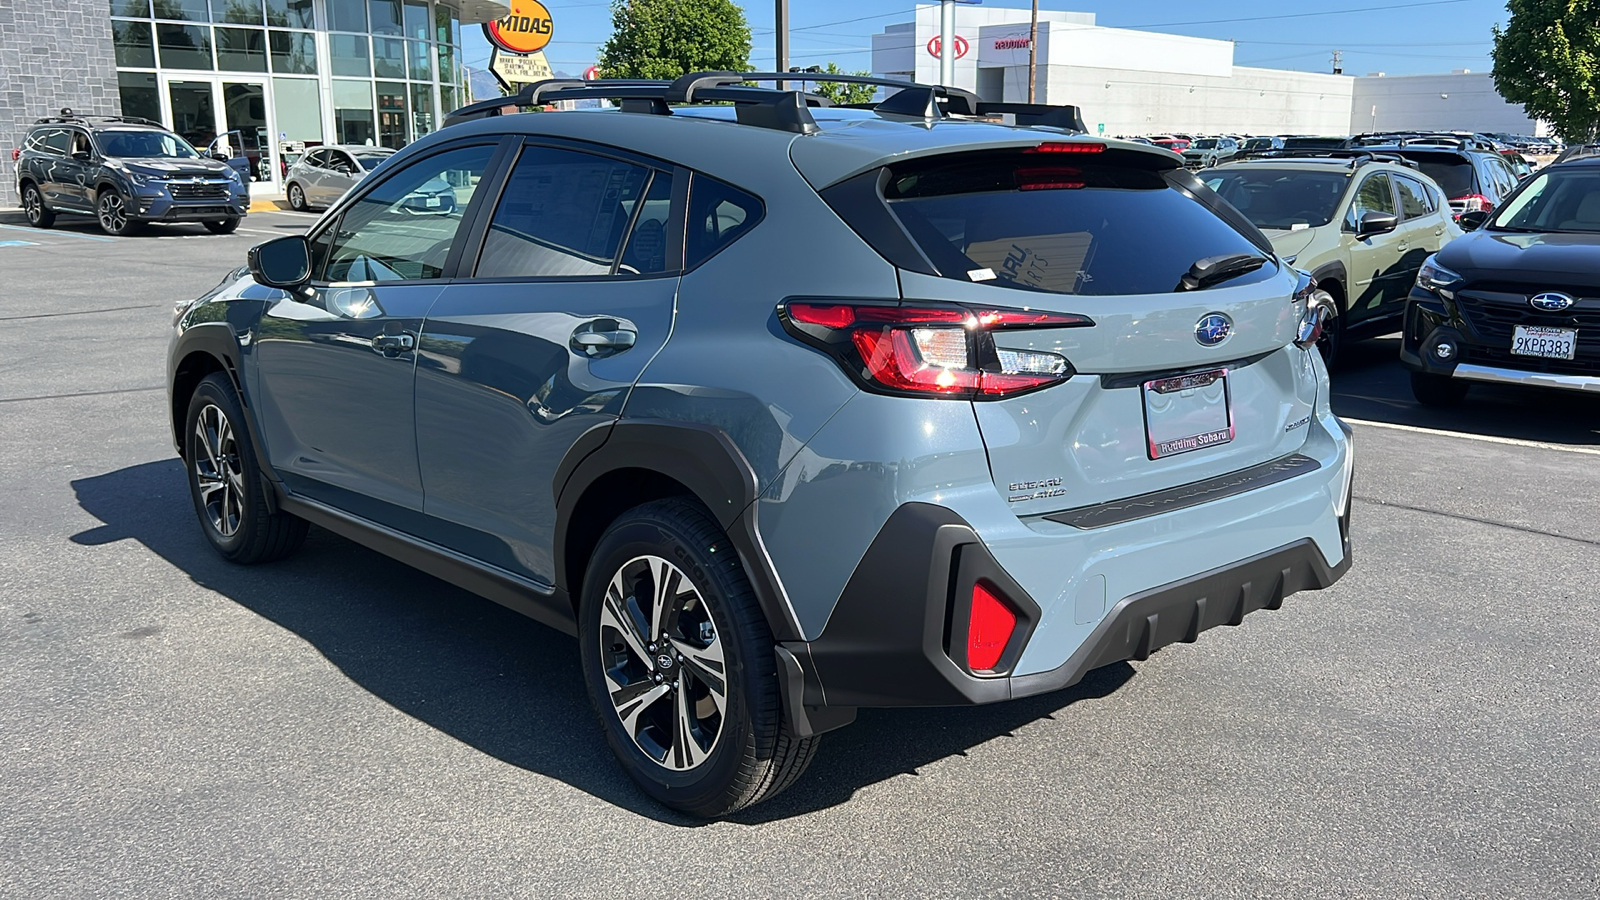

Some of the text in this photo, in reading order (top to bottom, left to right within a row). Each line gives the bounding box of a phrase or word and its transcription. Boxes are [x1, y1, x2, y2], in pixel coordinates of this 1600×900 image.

[497, 15, 552, 34] MIDAS
[1516, 337, 1571, 354] 9KPR383
[1160, 431, 1227, 454] Redding Subaru
[1009, 476, 1064, 491] SUBARU
